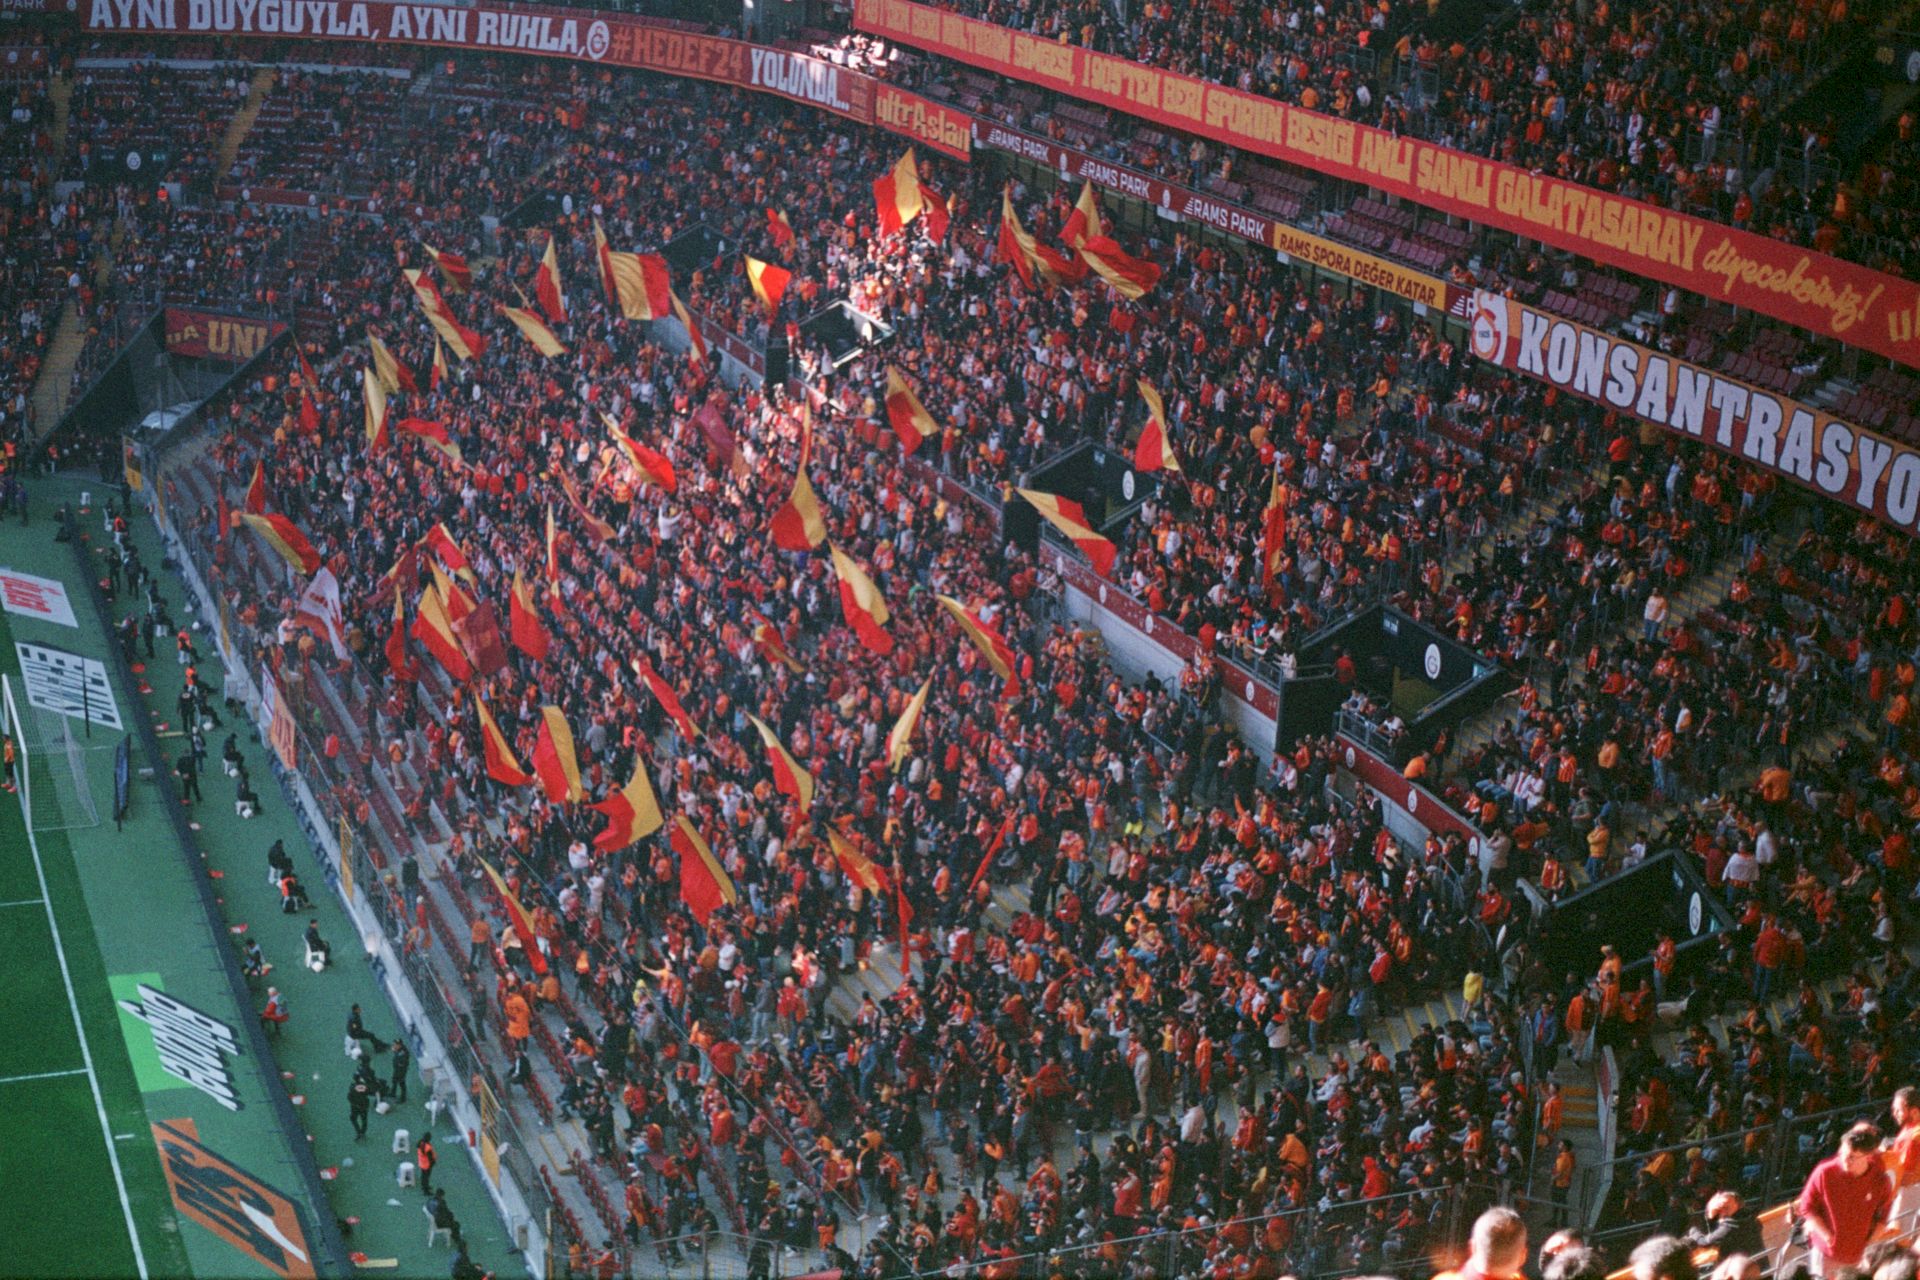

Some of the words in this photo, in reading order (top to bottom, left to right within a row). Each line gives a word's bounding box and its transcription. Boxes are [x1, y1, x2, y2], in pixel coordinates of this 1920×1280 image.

[89, 0, 177, 29] AYNI
[188, 0, 380, 41] DUYGUYLA,
[389, 5, 468, 43] AYNI
[477, 11, 586, 57] RUHLA,
[612, 26, 744, 80] #HEDEF24
[995, 129, 1022, 152] RAMS
[1023, 138, 1049, 163] PARK
[1088, 160, 1118, 187] RAMS
[1120, 173, 1149, 198] PARK
[1205, 87, 1284, 145] SPORUN
[1497, 168, 1703, 272] GALATASARAY
[1193, 199, 1228, 229] RAMS
[1231, 212, 1264, 242] PARK
[1280, 233, 1310, 259] RAMS
[1313, 244, 1350, 274] SPORA
[1353, 258, 1393, 289] DEĞER
[1396, 275, 1436, 305] KATAR
[1517, 309, 1920, 526] KONSANTRASYO
